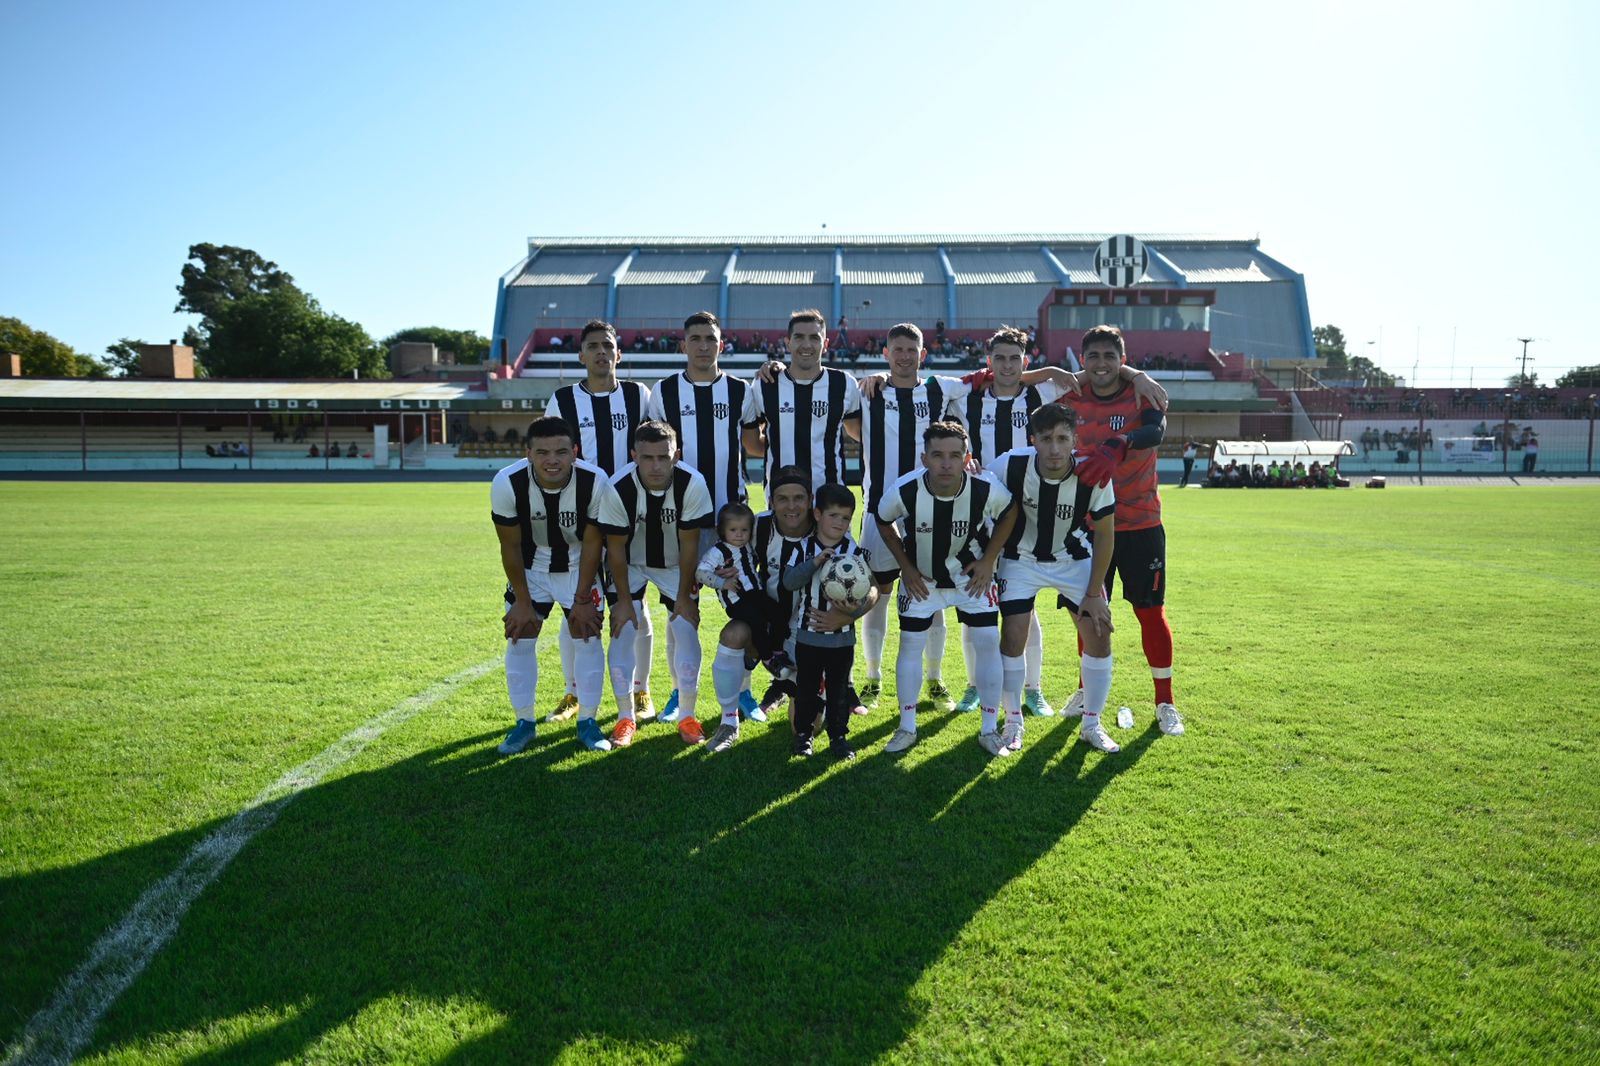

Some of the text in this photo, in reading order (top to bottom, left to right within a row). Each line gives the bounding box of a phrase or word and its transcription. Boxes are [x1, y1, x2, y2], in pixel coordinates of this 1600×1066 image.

[1102, 257, 1140, 267] BELL
[254, 399, 548, 409] 1904 CLUB BEL
